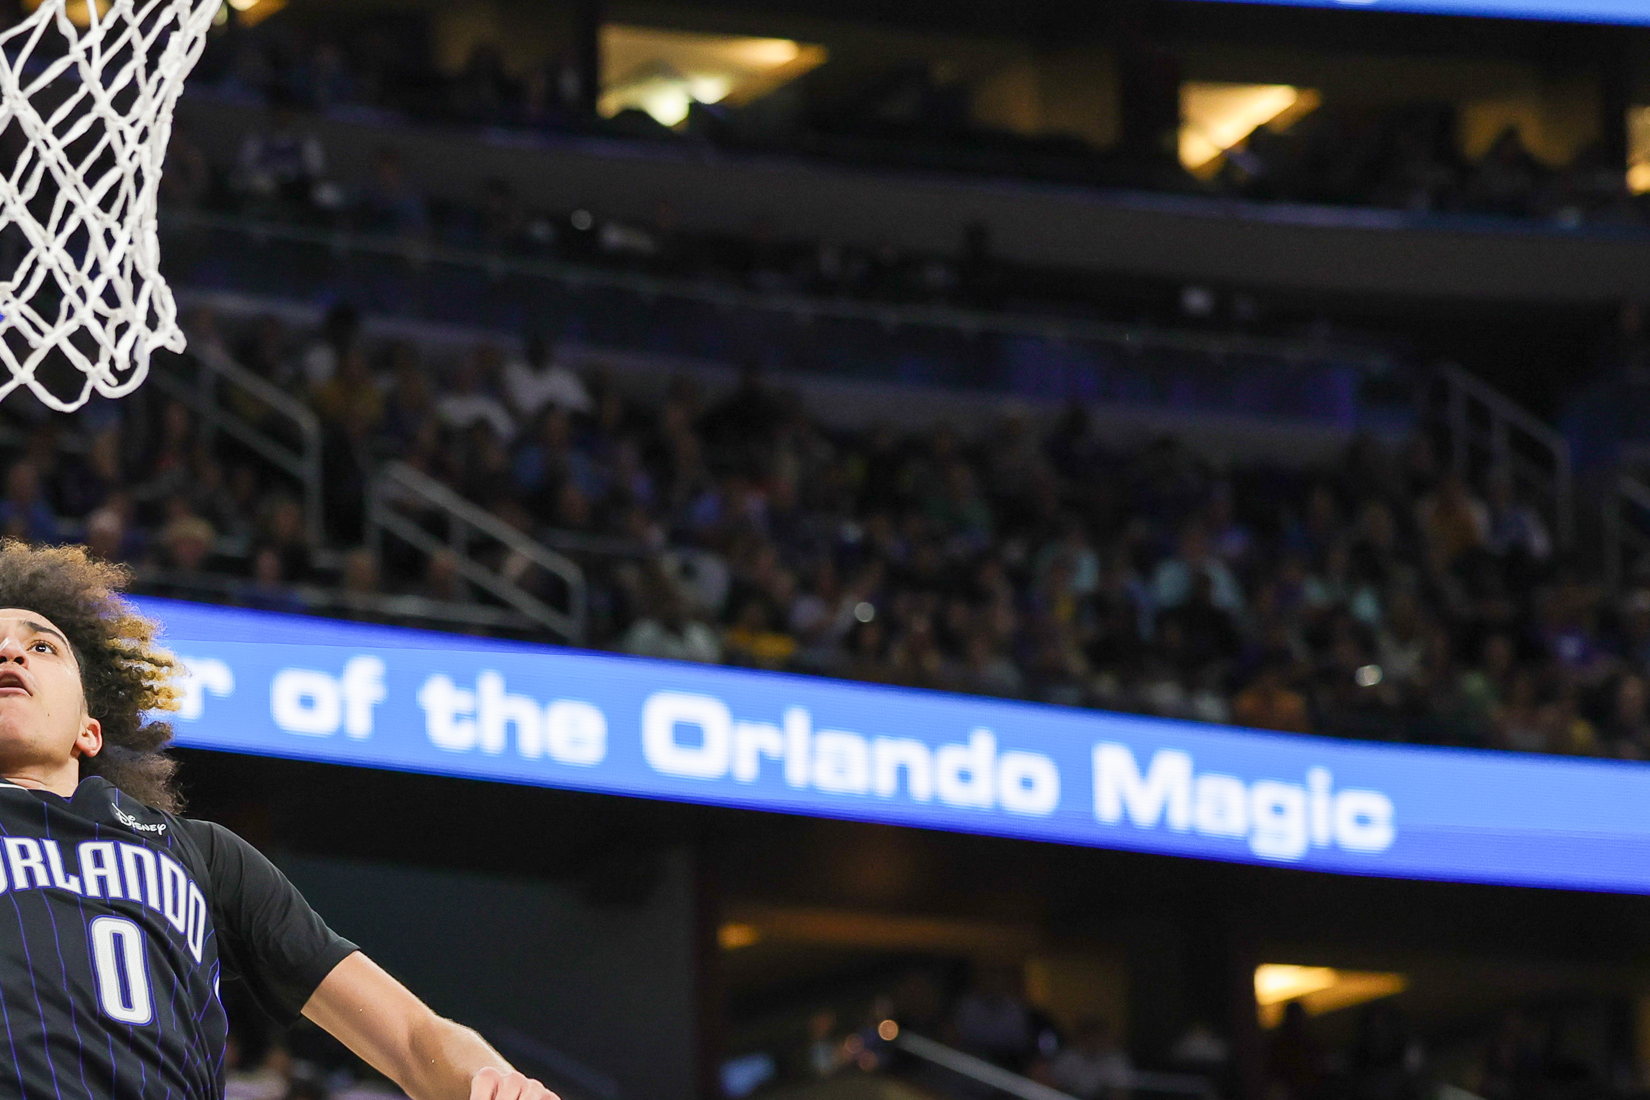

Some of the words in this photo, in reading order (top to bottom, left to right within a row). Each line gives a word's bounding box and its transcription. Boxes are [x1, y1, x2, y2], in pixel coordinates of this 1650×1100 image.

[269, 654, 388, 740] of
[416, 669, 609, 767] the
[640, 688, 1061, 817] Orlando
[1090, 741, 1396, 861] Magic
[89, 914, 155, 1027] 0
